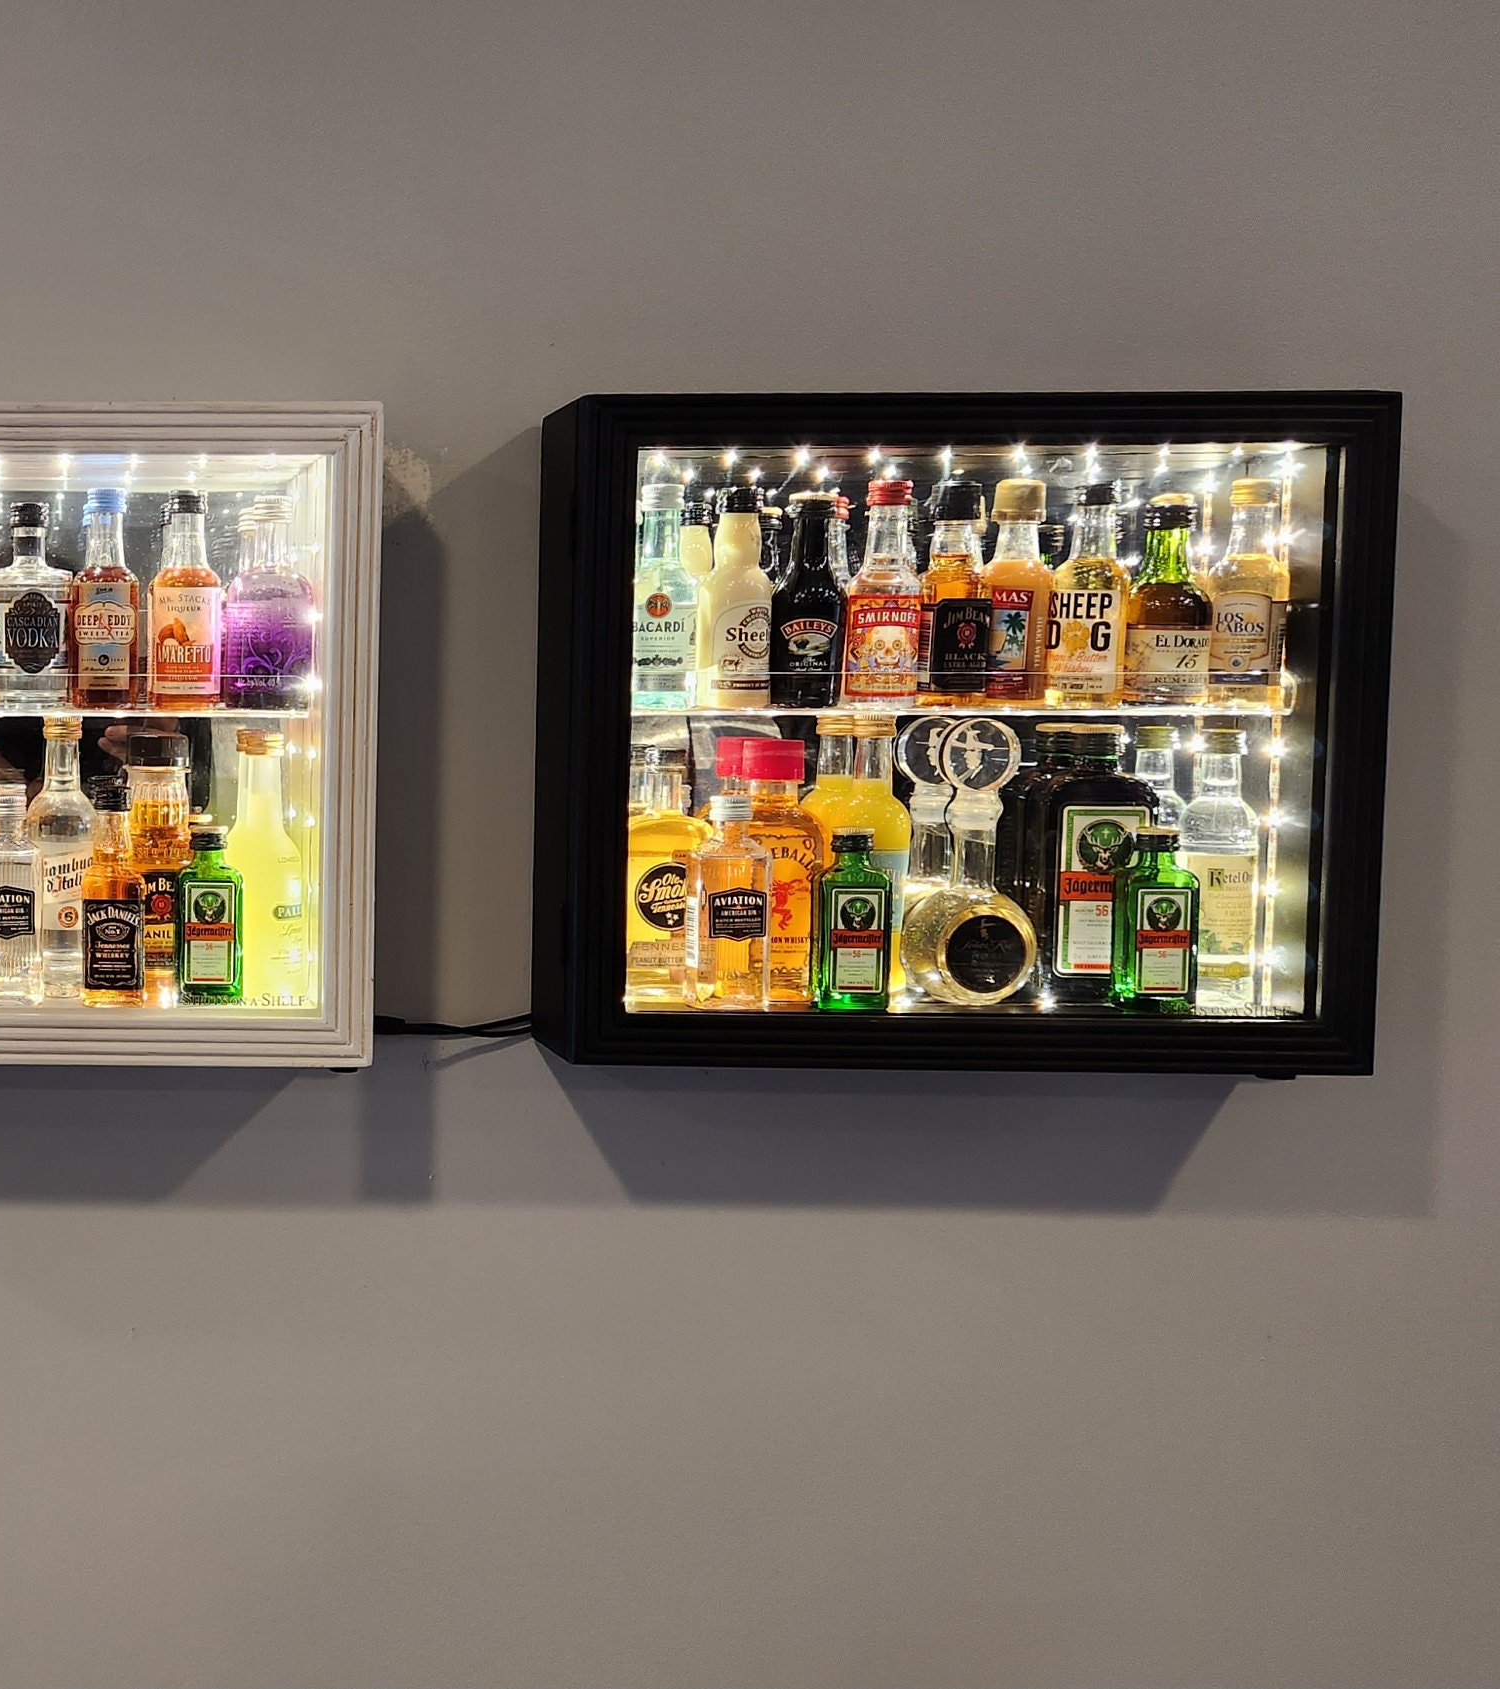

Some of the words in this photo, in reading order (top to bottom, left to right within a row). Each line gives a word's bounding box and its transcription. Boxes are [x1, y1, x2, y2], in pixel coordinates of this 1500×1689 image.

[179, 594, 211, 605] STACKS
[994, 591, 1028, 603] MAS
[167, 605, 201, 613] LIQUEUR
[1049, 592, 1113, 619] SHEEP
[7, 616, 58, 627] CASCADIAN
[77, 615, 99, 626] DEEP
[108, 615, 132, 626] EDDY
[858, 611, 917, 624] SMIRNOFF
[943, 611, 964, 629] JIM
[1216, 611, 1244, 624] LOS
[633, 617, 685, 633] BACARDÍ
[785, 621, 834, 634] BAILEYS
[1215, 621, 1265, 633] CABOS
[7, 627, 59, 648] VODKA
[726, 627, 769, 641] Sheel
[1045, 620, 1112, 652] DG
[1156, 635, 1170, 647] EL
[158, 645, 211, 664] AMARETTO
[944, 653, 986, 661] BLACK
[1176, 654, 1197, 669] 15
[771, 846, 814, 872] EBALL
[158, 877, 175, 892] BE
[662, 873, 681, 886] Ole
[1209, 868, 1241, 888] Ketel
[639, 878, 687, 903] Smok
[1064, 877, 1113, 895] Jägerm
[714, 896, 762, 907] AVIATION
[64, 911, 73, 922] 6
[87, 909, 107, 926] JACK
[108, 906, 140, 925] DANIEL'S
[277, 905, 301, 918] PALL
[1096, 904, 1109, 917] 56
[145, 929, 172, 939] ANIL
[186, 925, 233, 938] Jägermeister
[784, 936, 808, 945] WHISKY
[833, 932, 882, 945] Jägermeister
[1139, 933, 1188, 945] Jägermeister
[633, 942, 685, 951] TENNES
[261, 992, 306, 1007] SHELF
